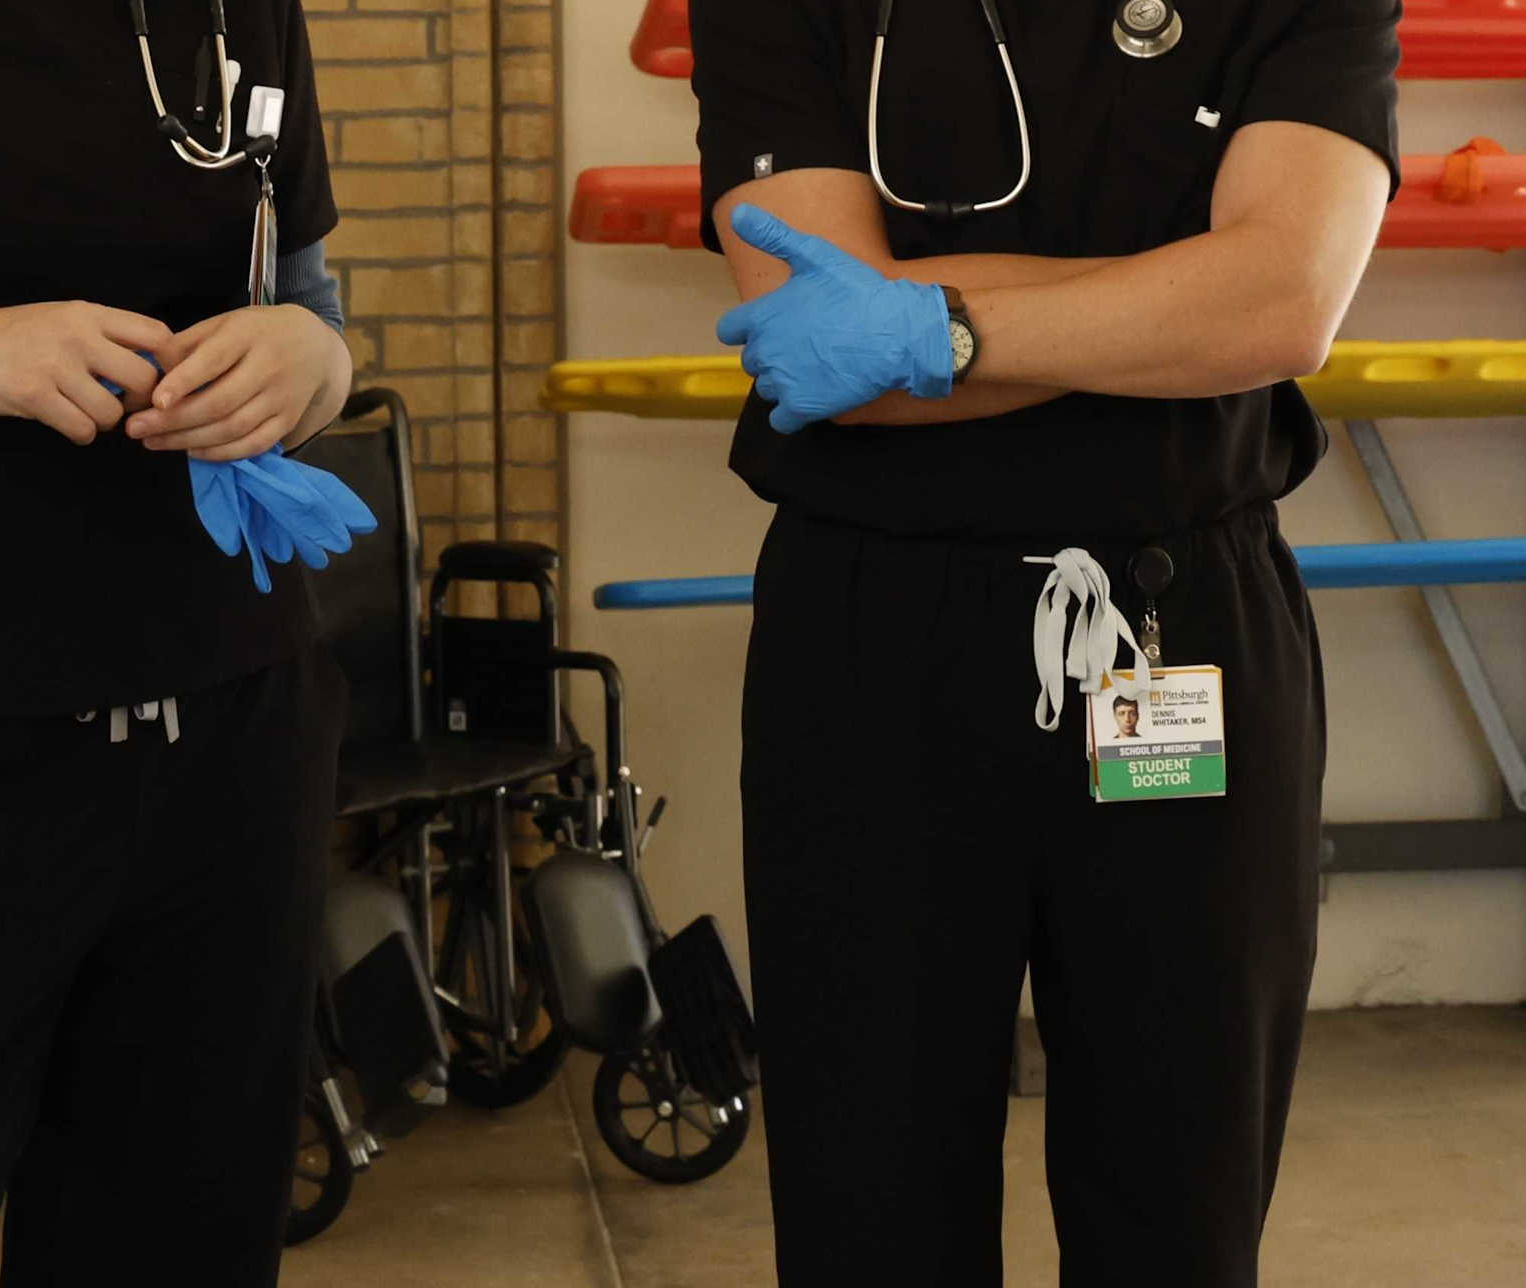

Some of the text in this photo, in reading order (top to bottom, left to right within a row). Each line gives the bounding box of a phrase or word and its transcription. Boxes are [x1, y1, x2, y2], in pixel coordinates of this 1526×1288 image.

[1119, 743, 1201, 756] SCHOOL OF MEDICINE
[1128, 758, 1192, 774] STUDENT
[1132, 772, 1191, 788] DOCTOR
